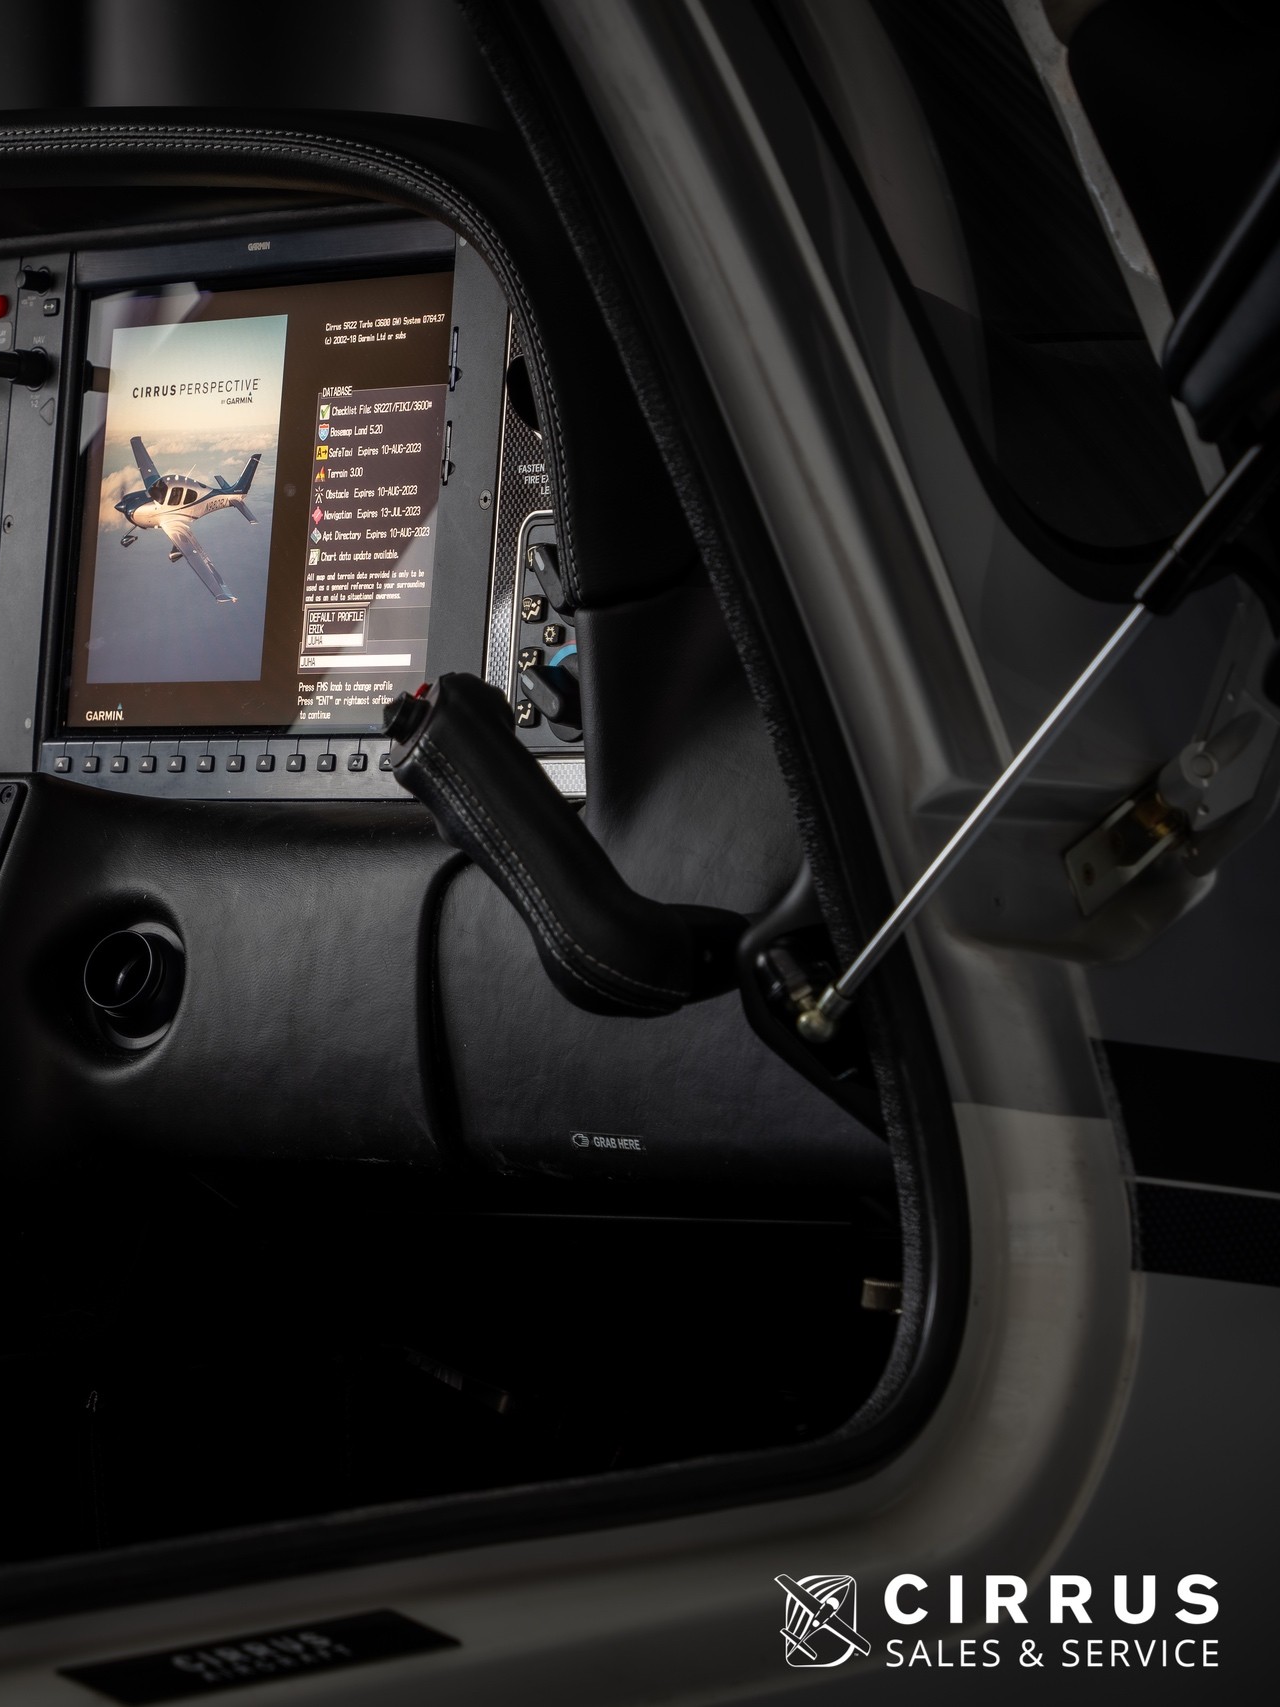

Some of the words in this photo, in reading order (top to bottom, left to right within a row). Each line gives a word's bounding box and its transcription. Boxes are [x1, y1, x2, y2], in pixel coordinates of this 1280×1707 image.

[326, 323, 342, 332] Cirrus
[344, 322, 357, 330] SR22
[403, 317, 421, 326] System
[358, 334, 375, 343] Garmin
[377, 333, 386, 341] Ltd
[395, 332, 406, 340] subs
[133, 385, 176, 398] CIRRUS
[180, 379, 259, 395] PERSPECTIVE
[323, 386, 352, 397] DATABASE
[226, 397, 252, 405] GARMIN
[332, 405, 357, 416] Checklist
[359, 404, 372, 414] File:
[331, 427, 352, 438] Basemap
[355, 426, 368, 435] Land
[370, 425, 383, 434] 5.20
[358, 446, 378, 456] Expires
[382, 443, 421, 454] 10-AUG-2023
[328, 469, 347, 479] Terrain
[350, 467, 363, 477] 3.00
[518, 464, 544, 473] FASTEN
[524, 476, 539, 484] FIRE
[326, 489, 349, 499] Obstacle
[354, 487, 374, 498] Expires
[378, 485, 417, 496] 10-AUG-2023
[324, 510, 352, 520] Navigation
[357, 508, 378, 519] Expires
[381, 507, 420, 517] 13-JUL-2023
[322, 531, 332, 541] Apt
[335, 530, 361, 540] Directory
[366, 529, 386, 539] Expires
[390, 527, 430, 537] 10-AUG-2023
[321, 552, 336, 562] Chart
[339, 552, 351, 561] data
[353, 551, 371, 561] update
[310, 612, 335, 622] DEFAULT
[338, 611, 363, 621] PROFILE
[309, 624, 324, 634] ERIK
[308, 636, 322, 645] JUHA
[301, 658, 315, 667] JUHA
[299, 682, 314, 692] Press
[345, 683, 351, 691] to
[374, 681, 393, 691] profile
[298, 696, 313, 706] Press
[86, 710, 124, 721] GARMIN
[300, 711, 306, 719] to
[308, 710, 331, 719] continue
[593, 1136, 617, 1149] GRAB
[618, 1137, 640, 1151] HERE
